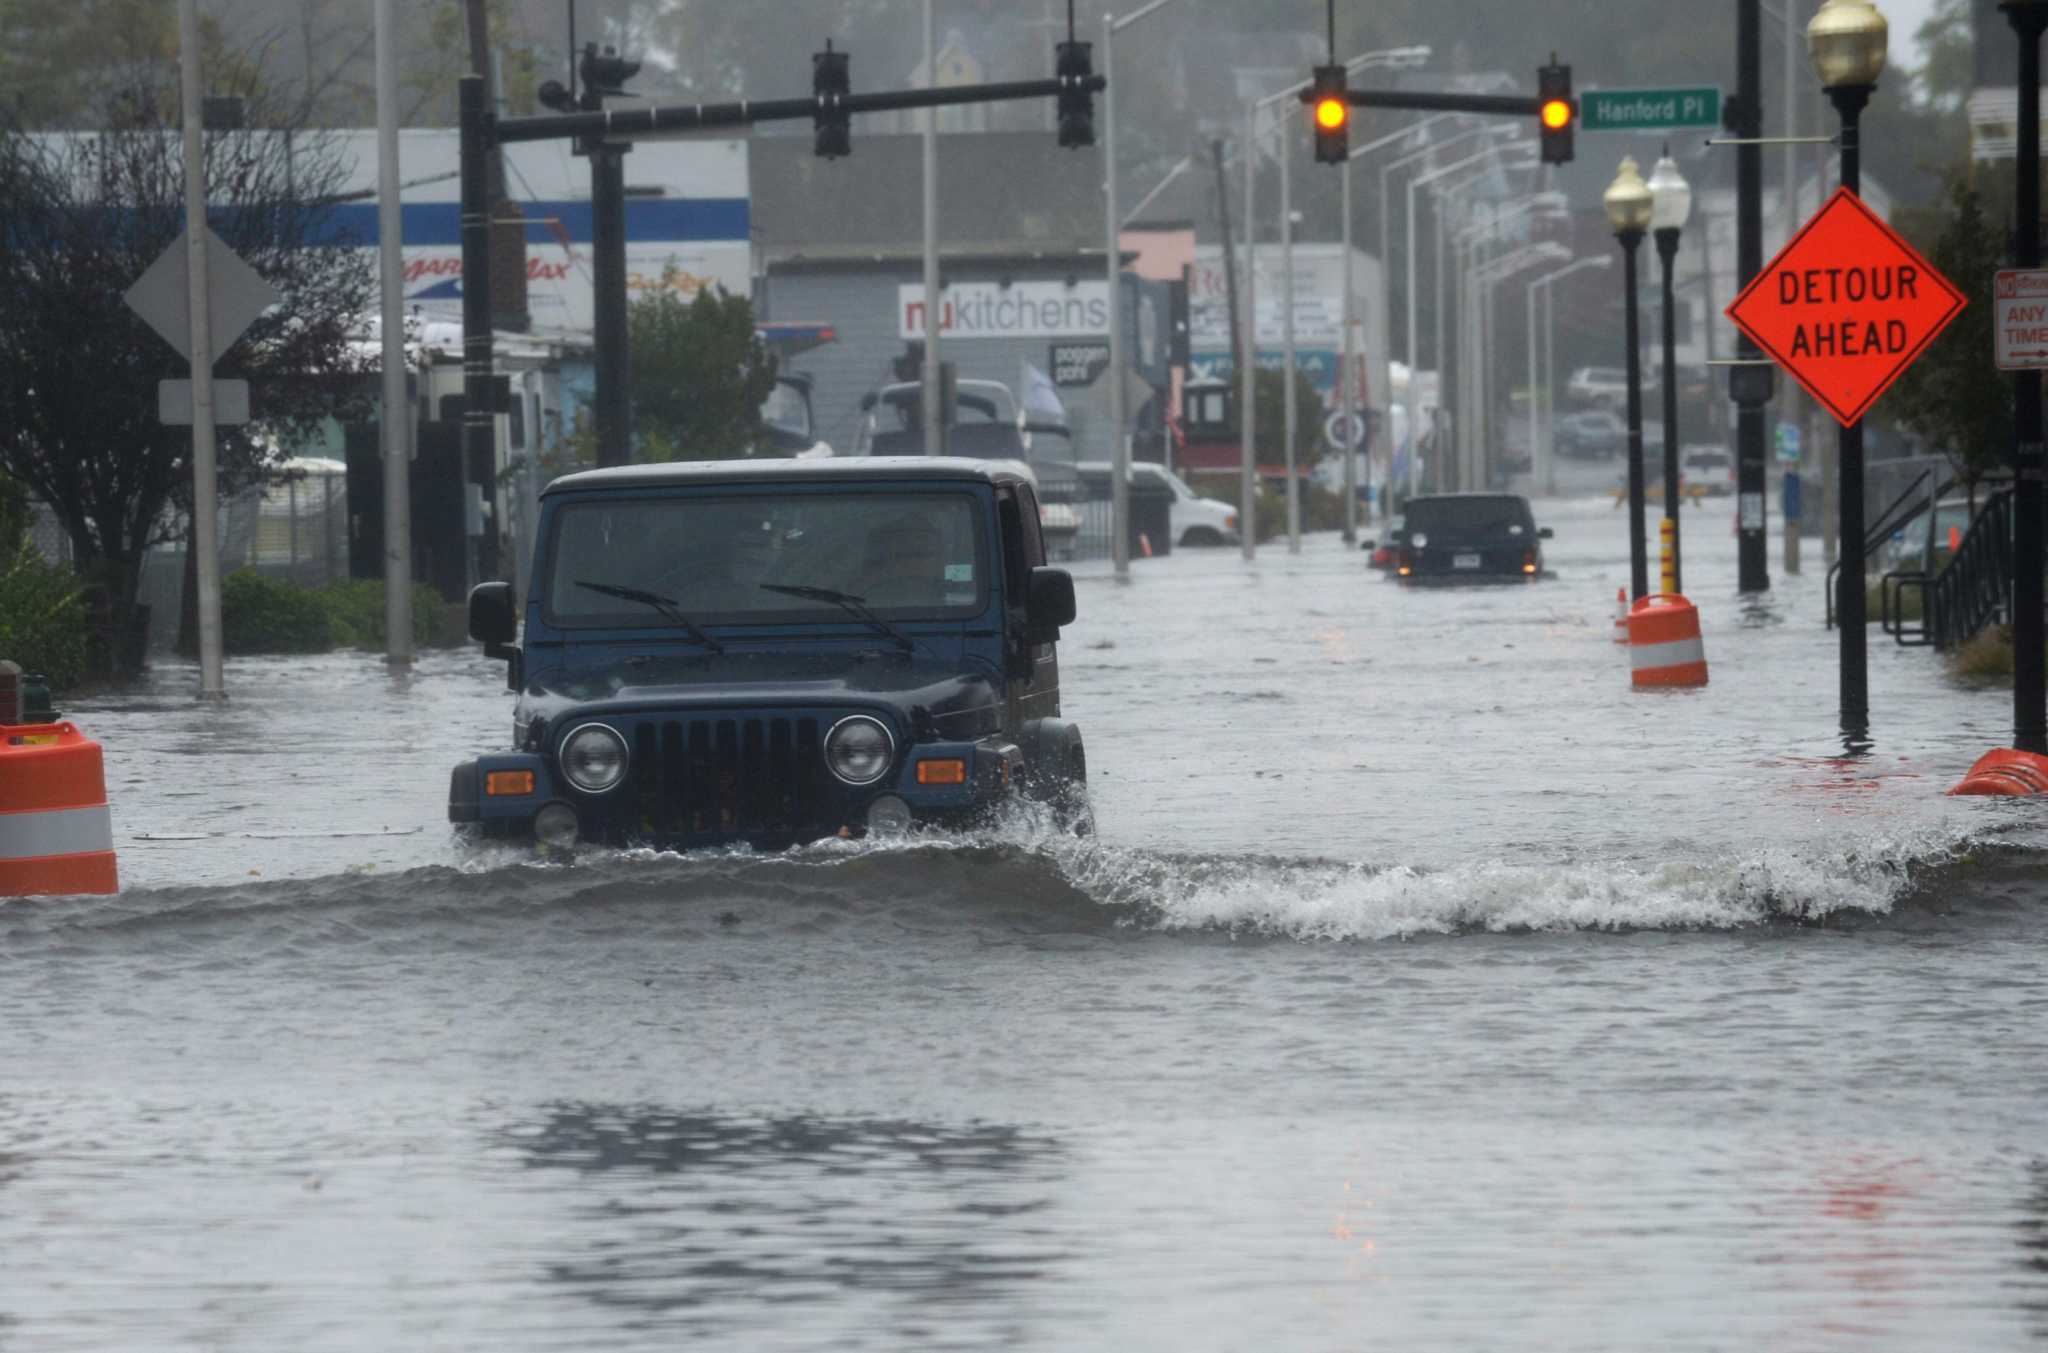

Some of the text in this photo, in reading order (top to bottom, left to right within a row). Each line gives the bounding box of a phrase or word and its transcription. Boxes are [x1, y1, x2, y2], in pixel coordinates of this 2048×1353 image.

[1597, 96, 1705, 121] Hanford Pl
[1779, 265, 1918, 305] DETOUR
[2008, 304, 2045, 322] ANY
[1791, 319, 1907, 358] AHEAD
[2004, 327, 2048, 345] TIME
